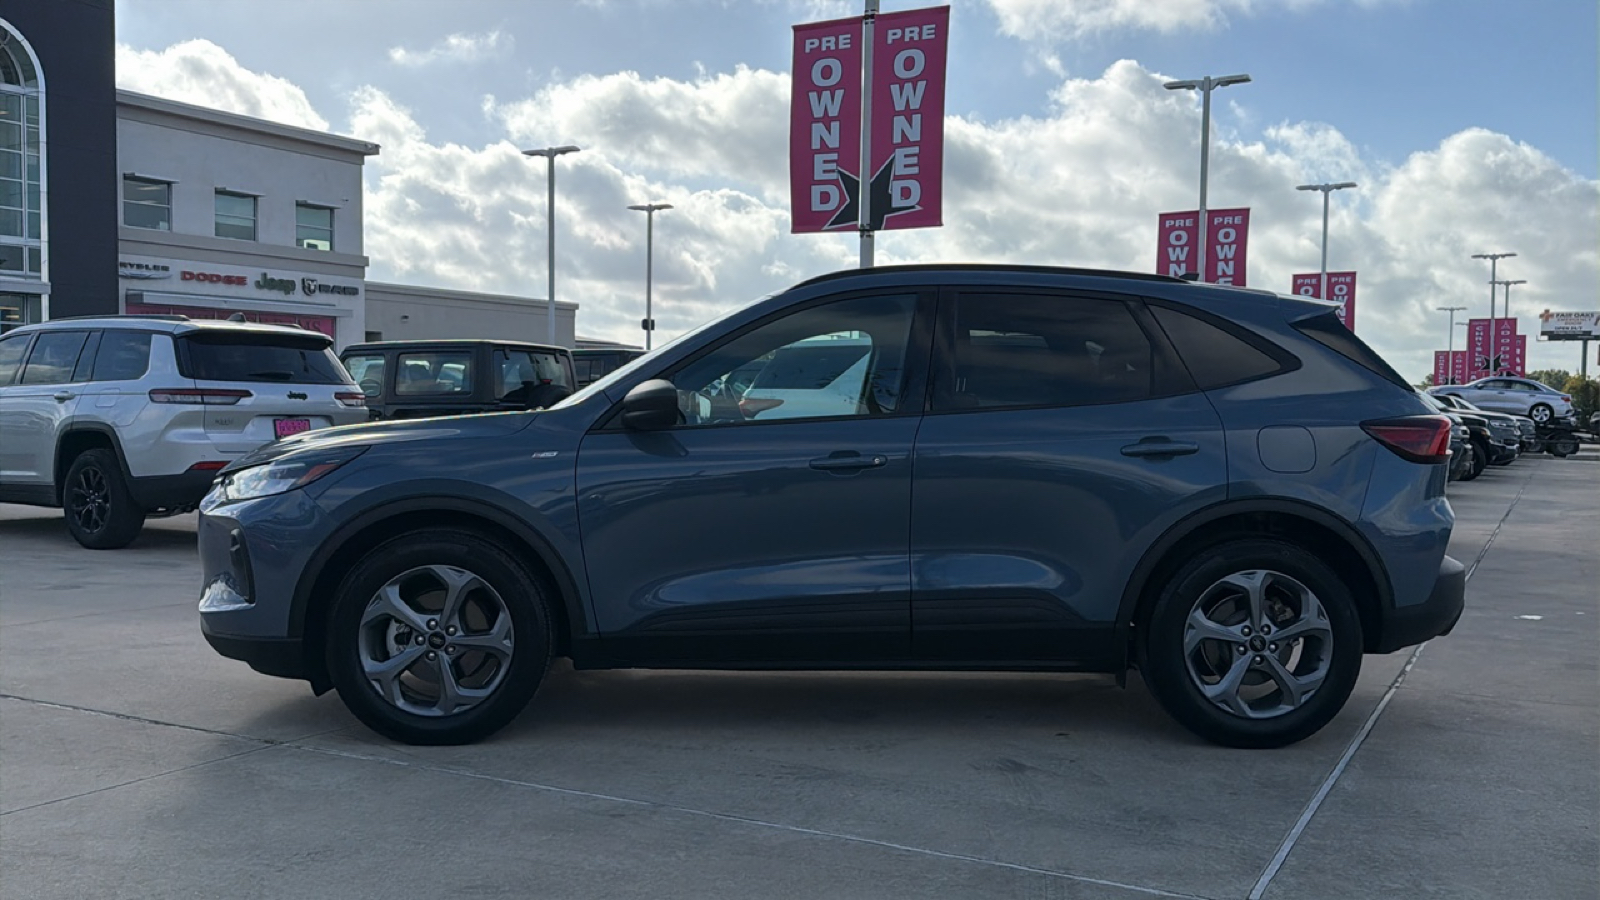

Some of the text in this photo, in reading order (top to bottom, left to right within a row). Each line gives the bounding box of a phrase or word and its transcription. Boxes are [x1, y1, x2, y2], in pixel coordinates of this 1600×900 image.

[805, 34, 851, 53] PRE
[887, 24, 936, 44] PRE
[808, 58, 844, 211] OWNED
[890, 49, 927, 208] OWNED
[1165, 218, 1194, 228] PRE
[1214, 216, 1243, 225] PRE
[180, 270, 248, 286] DODGE
[254, 272, 296, 295] Jeep
[319, 284, 359, 296] RAM
